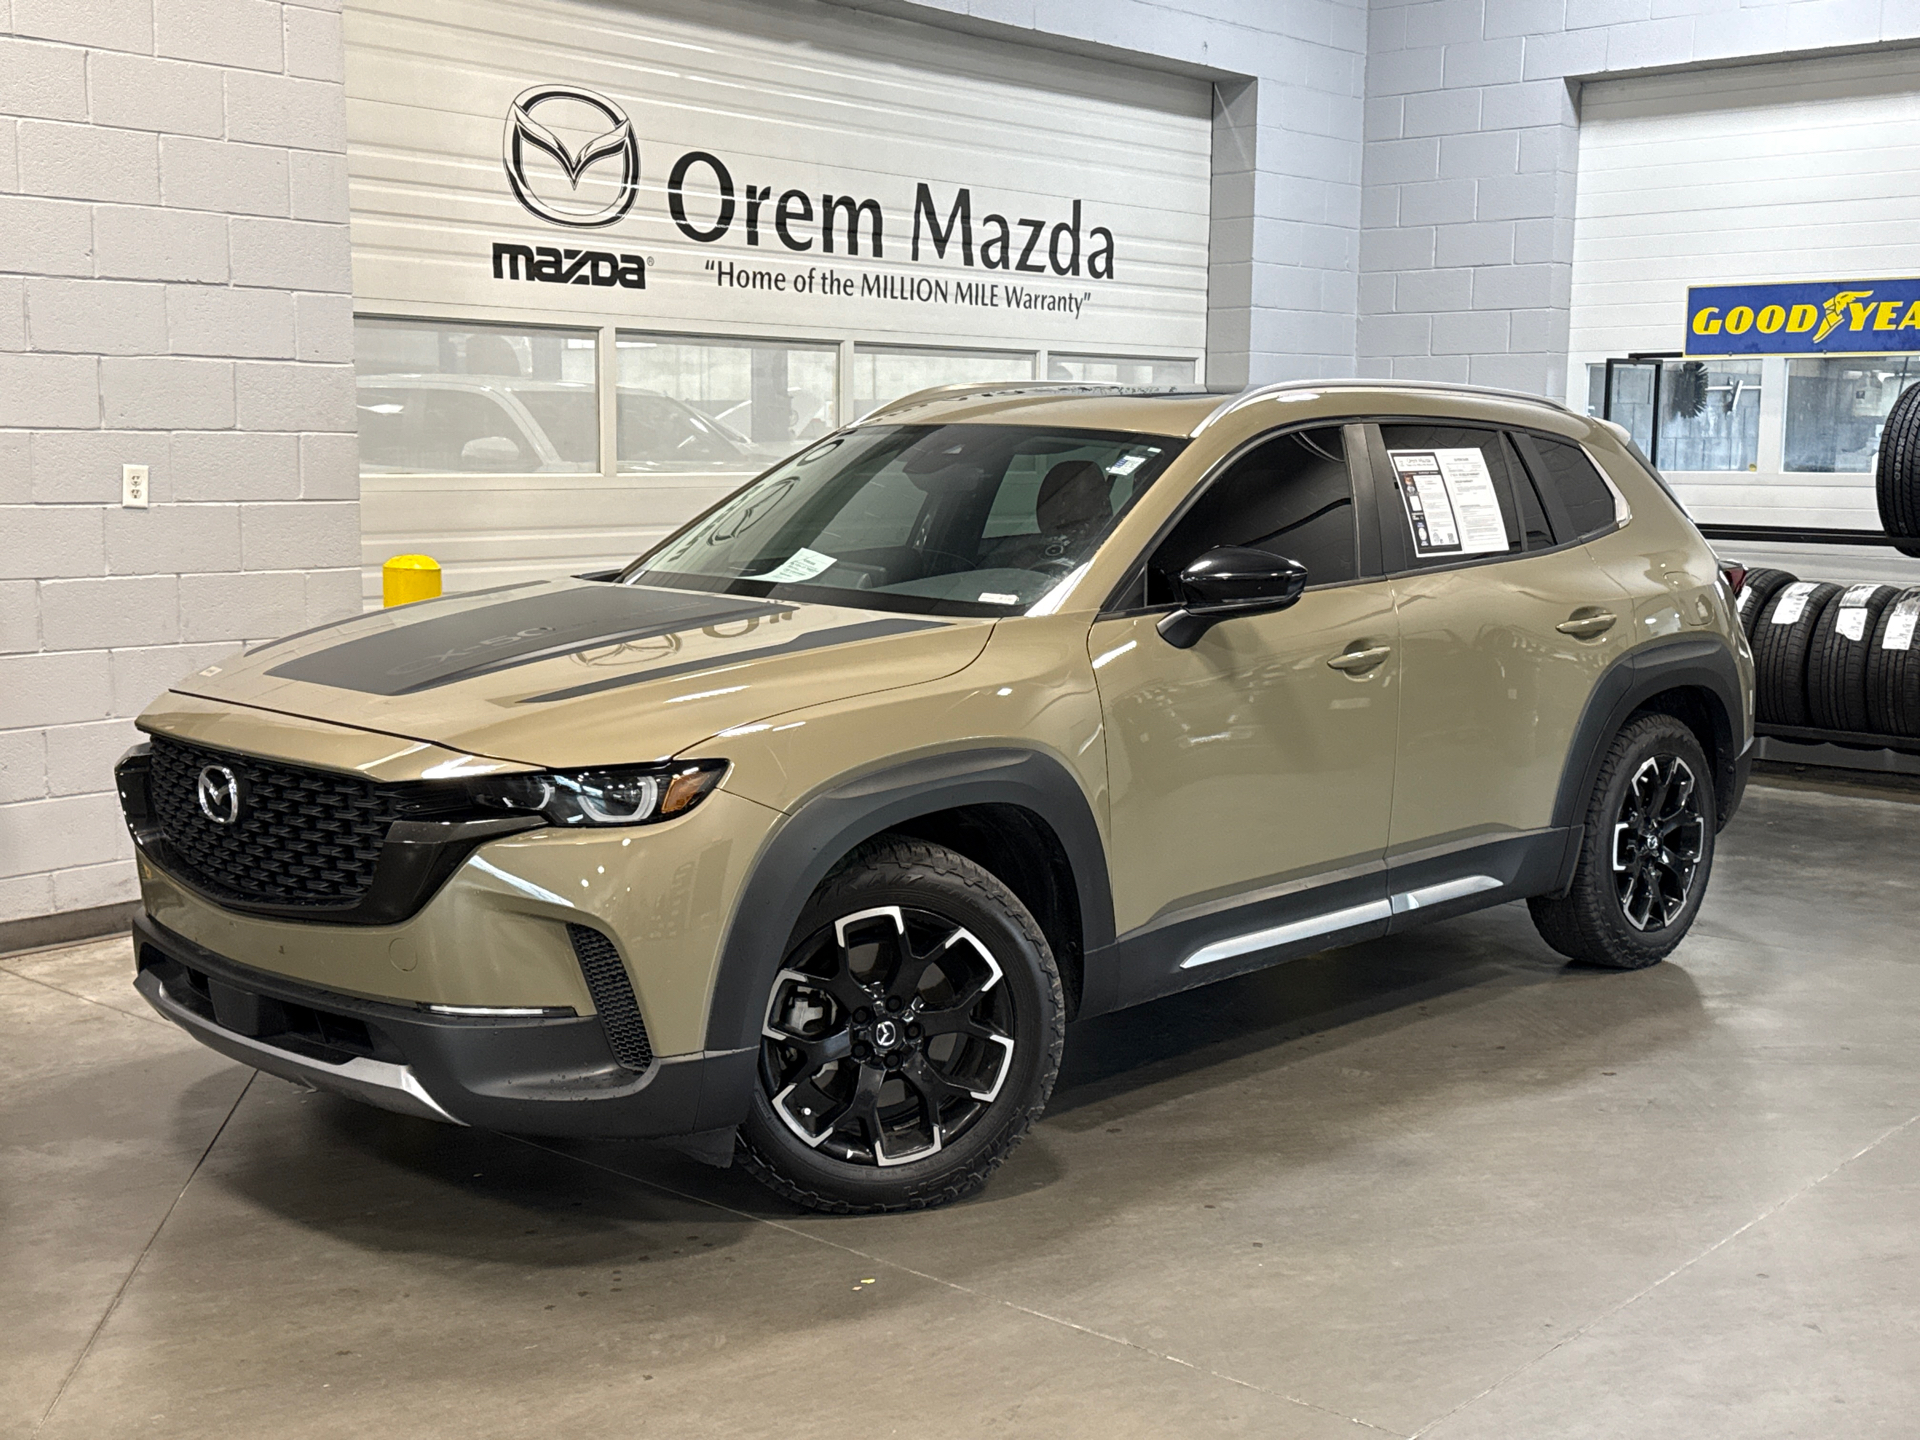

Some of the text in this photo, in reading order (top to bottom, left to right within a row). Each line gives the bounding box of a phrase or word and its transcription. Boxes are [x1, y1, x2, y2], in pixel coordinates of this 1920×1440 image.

[667, 151, 1115, 280] Orem Mazda
[793, 267, 816, 294] of
[820, 269, 855, 297] the
[861, 273, 948, 303] MILLION
[955, 281, 999, 307] MILE
